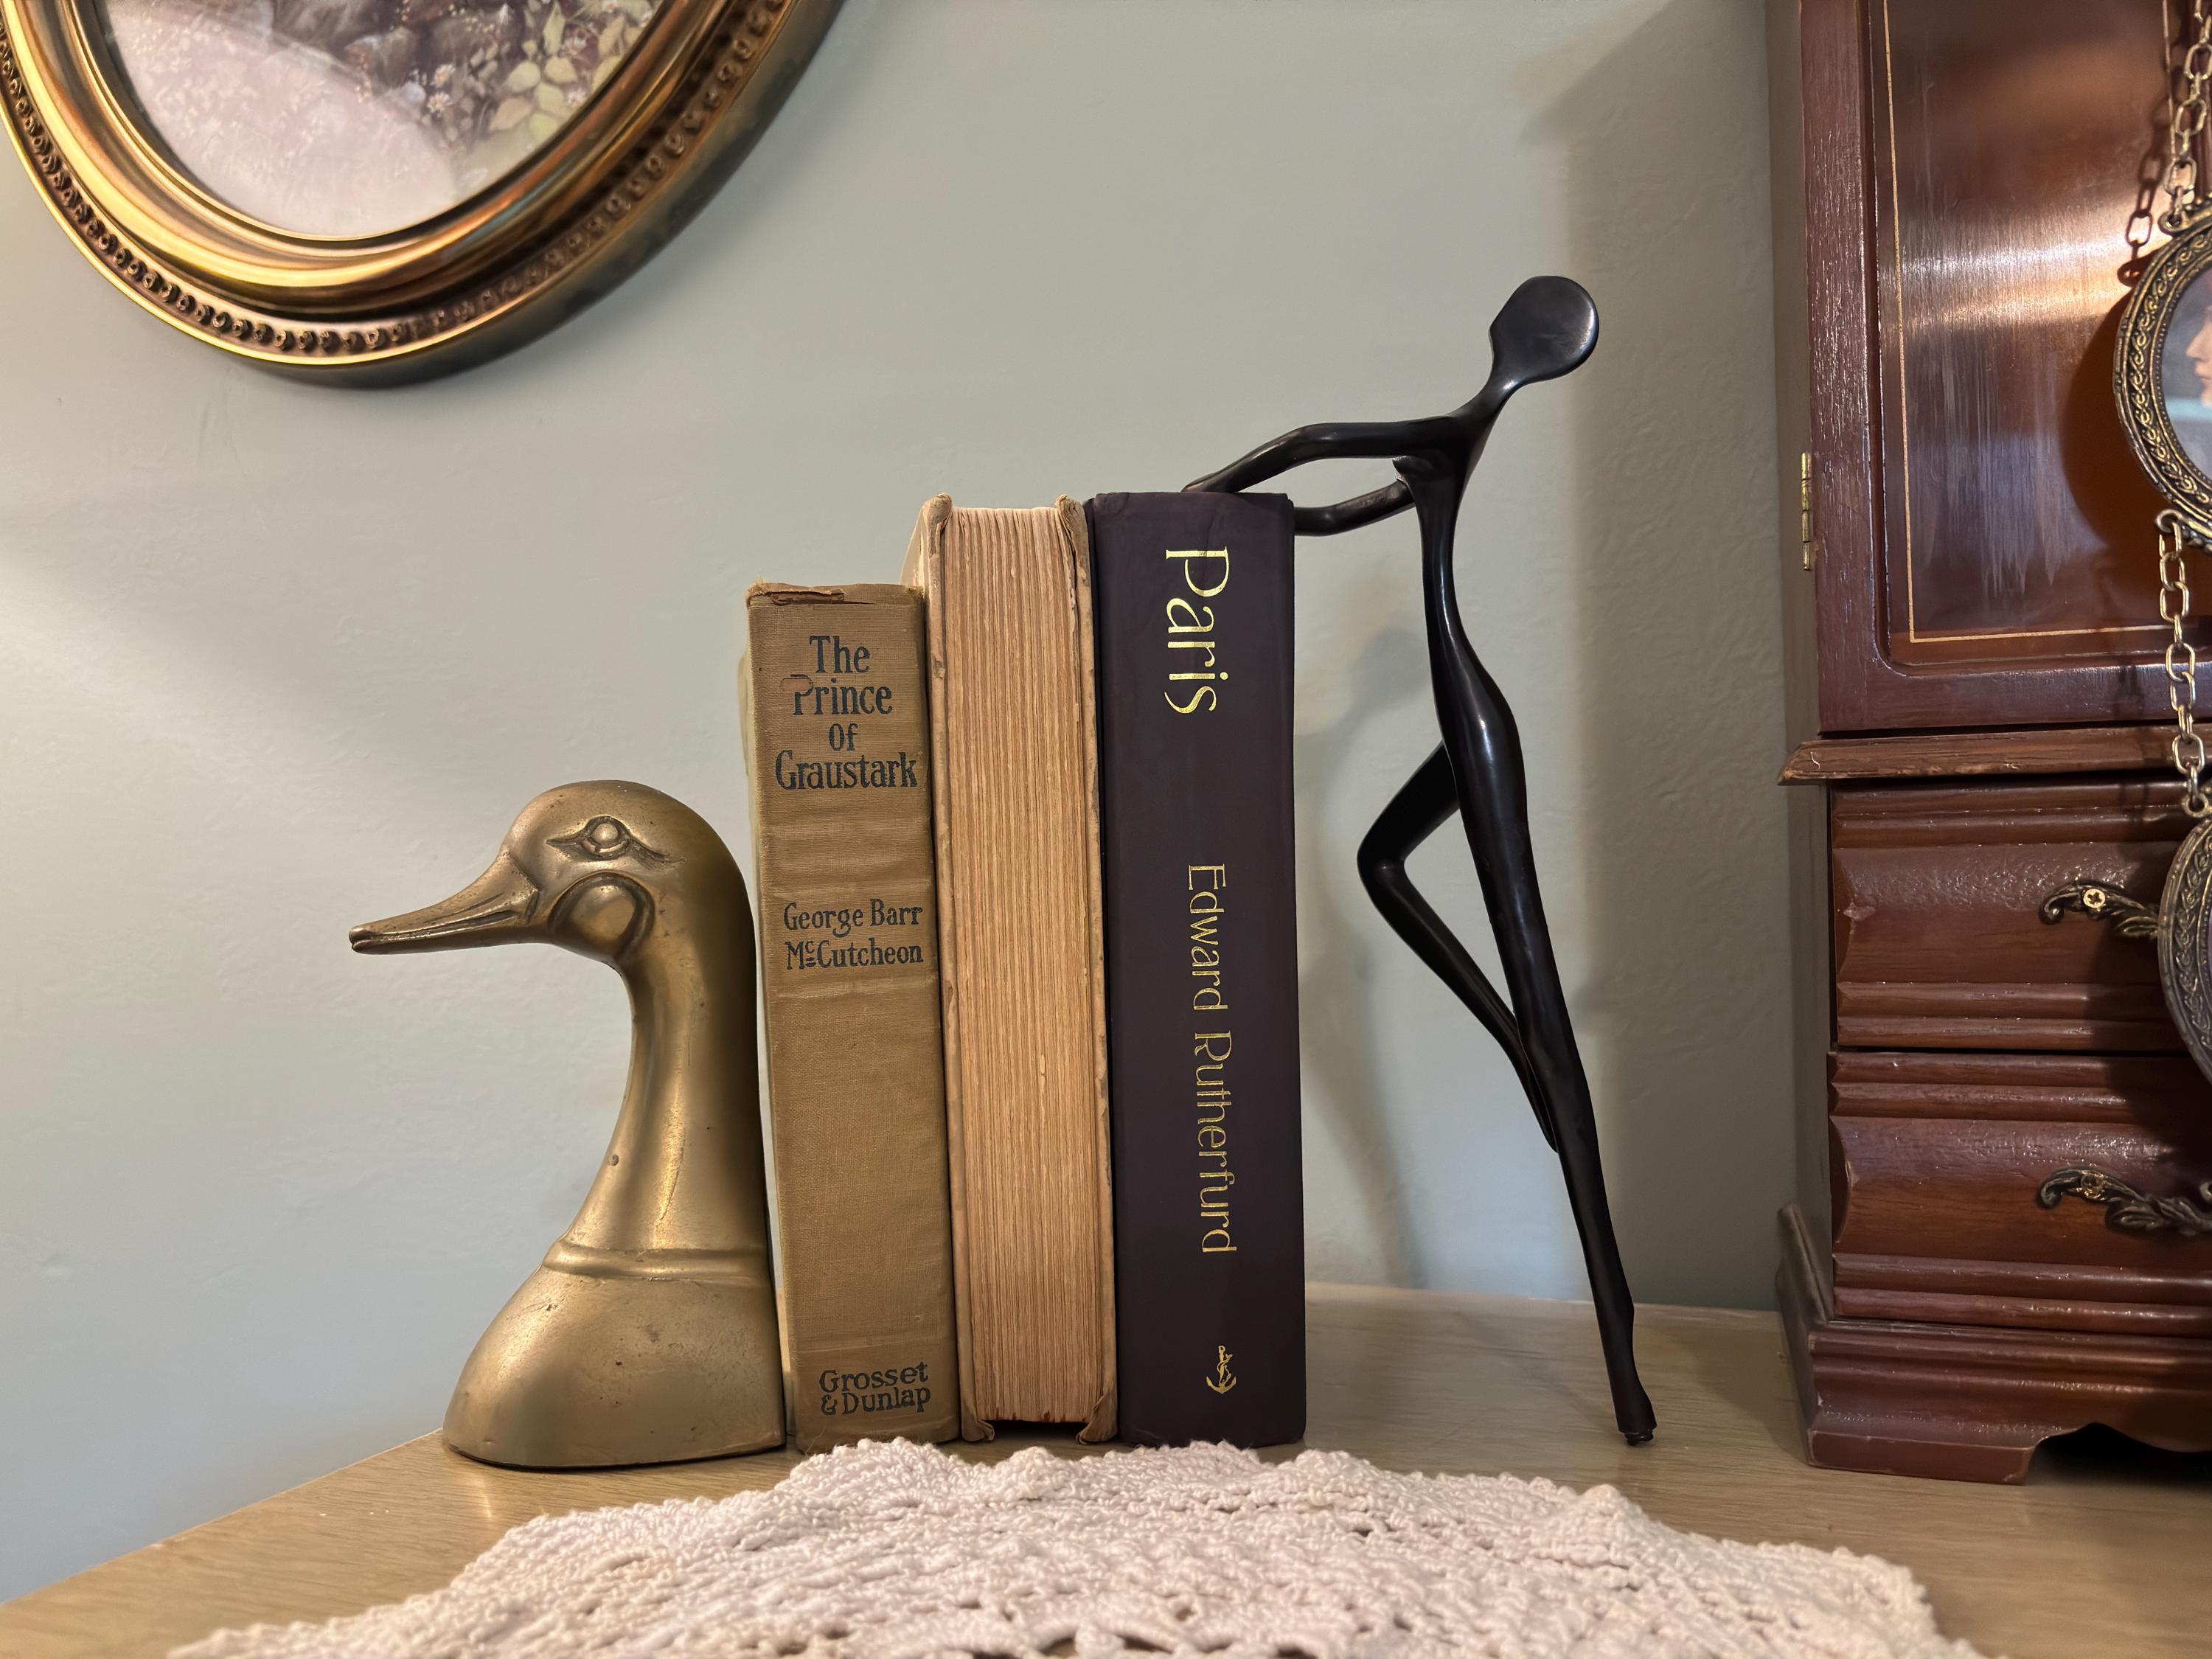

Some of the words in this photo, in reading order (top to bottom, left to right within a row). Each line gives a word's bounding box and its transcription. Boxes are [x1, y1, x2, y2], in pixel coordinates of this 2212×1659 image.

[1164, 546, 1230, 714] Paris
[809, 636, 871, 673] The
[789, 674, 893, 716] Prince
[775, 749, 918, 790] Graustark
[784, 902, 863, 937] George
[870, 898, 923, 926] Barr
[1186, 864, 1228, 1011] Edward
[785, 938, 924, 970] McCutcheon
[1193, 1031, 1237, 1253] Rutherfurd
[818, 1360, 929, 1393] Grosset
[821, 1394, 838, 1416] &
[841, 1386, 931, 1415] Dunlap
